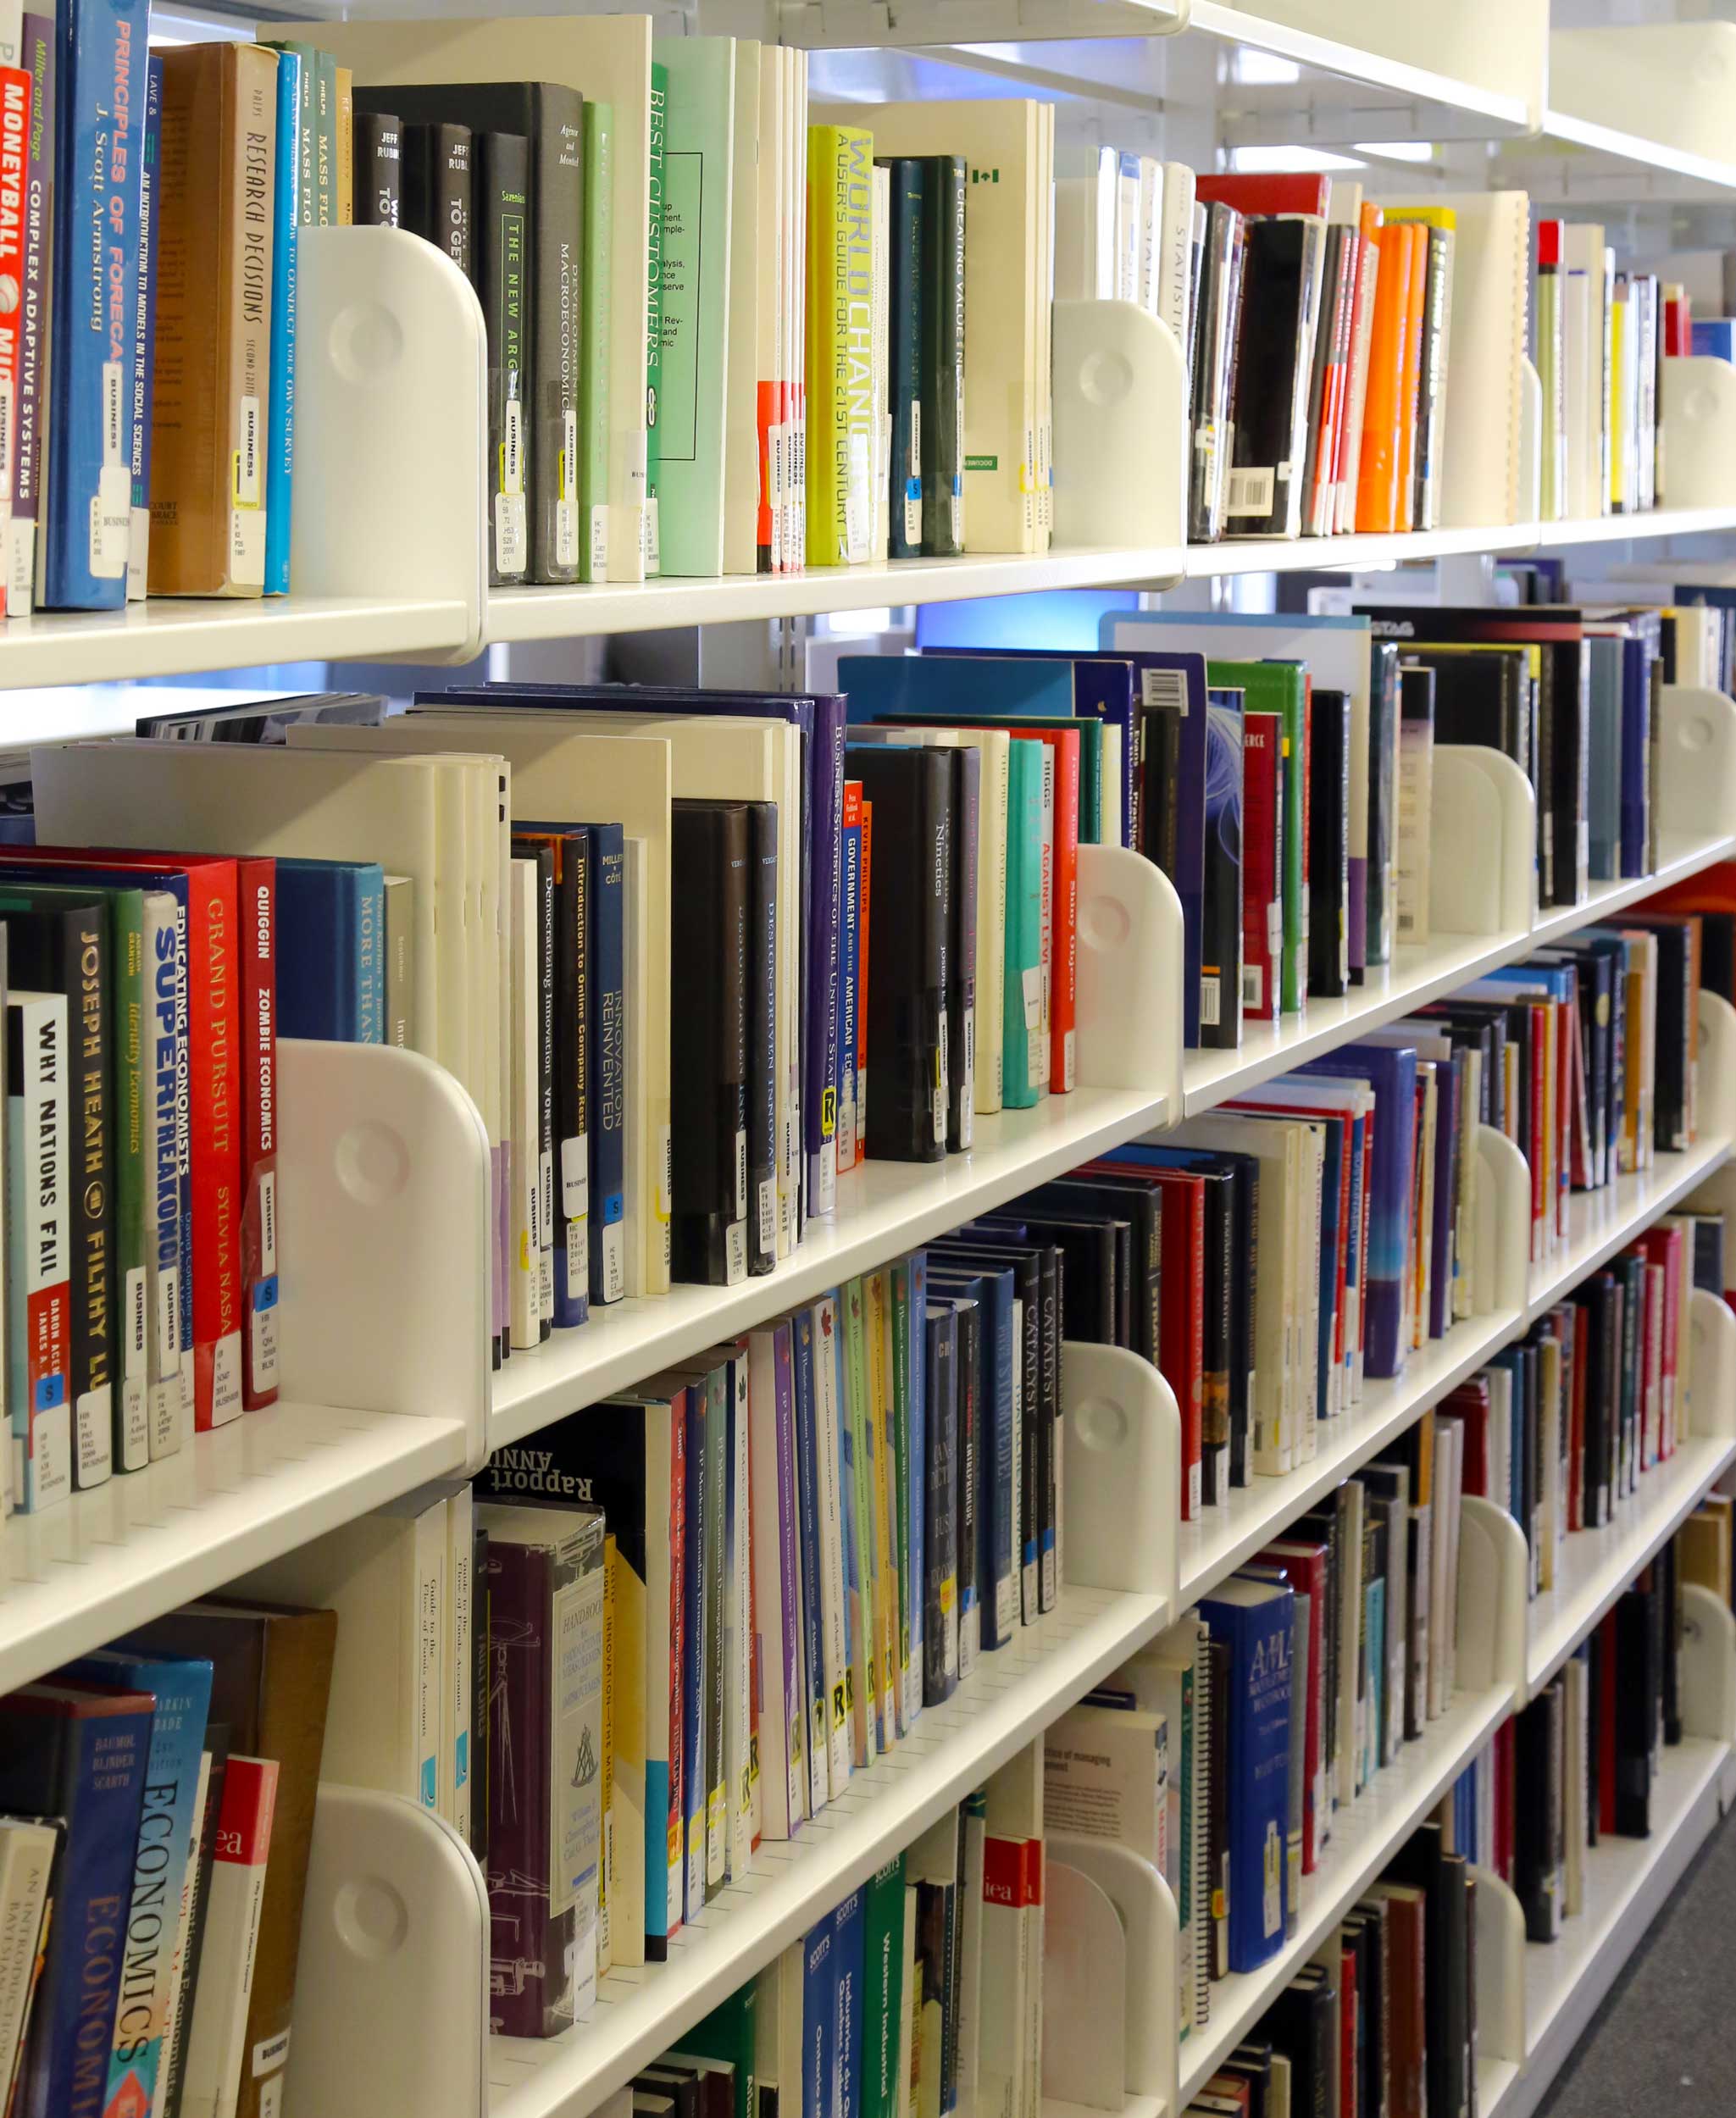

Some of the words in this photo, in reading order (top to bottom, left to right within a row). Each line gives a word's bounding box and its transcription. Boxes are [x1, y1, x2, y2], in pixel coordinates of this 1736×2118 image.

[33, 39, 47, 83] Miller
[149, 74, 158, 103] LAVE
[33, 86, 46, 119] and
[95, 103, 108, 122] J.
[109, 20, 130, 184] PRINCIPLES
[148, 106, 157, 116] &
[649, 88, 666, 169] BEST
[31, 121, 43, 162] Page
[92, 130, 108, 192] Scott
[302, 127, 311, 180] MASS
[318, 135, 328, 186] MASS
[381, 131, 398, 144] JEFF
[565, 141, 575, 151] and
[837, 133, 847, 147] A
[0, 82, 25, 257] MONEYBALL
[245, 132, 267, 223] RESEARCH
[501, 190, 526, 204] Saxenian
[835, 153, 848, 224] USER'S
[27, 179, 42, 282] COMPLEX
[109, 196, 125, 236] OF
[450, 198, 462, 225] TO
[507, 224, 519, 262] THE
[957, 189, 966, 277] CREATING
[89, 200, 107, 332] Armstrong
[137, 276, 147, 291] TO
[242, 231, 264, 324] DECISIONS
[646, 175, 662, 368] CUSTOMERS
[835, 230, 847, 290] GUIDE
[109, 247, 124, 365] FORECA
[135, 293, 147, 340] MODELS
[286, 268, 295, 336] CONDUCT
[507, 274, 519, 319] NEW
[835, 297, 847, 336] FOR
[956, 281, 965, 338] VALUE
[23, 288, 38, 396] ADAPTIVE
[134, 358, 144, 379] THE
[135, 342, 145, 355] IN
[246, 339, 256, 370] SECOND
[835, 344, 846, 380] THE
[132, 380, 144, 421] SOCIAL
[286, 379, 294, 415] OWN
[836, 385, 847, 434] 21ST
[19, 403, 33, 500] SYSTEMS
[131, 424, 142, 475] SCIENCES
[284, 417, 293, 475] SURVEY
[835, 440, 848, 525] CENTURY
[912, 483, 918, 495] S
[833, 725, 842, 807] BUSINESS
[1043, 761, 1051, 809] HIGGS
[831, 812, 840, 902] STATISTICS
[846, 838, 856, 930] GOVERNMENT
[935, 824, 945, 897] Nineties
[1042, 843, 1051, 918] AGAINST
[257, 886, 269, 959] QUIGGIN
[360, 896, 373, 968] MORE
[542, 876, 553, 989] Democratizing
[830, 908, 838, 928] OF
[1068, 880, 1077, 928] Shiny
[176, 906, 186, 1028] EDUCATING
[208, 898, 225, 1009] GRAND
[576, 952, 585, 969] to
[80, 931, 102, 1058] JOSEPH
[258, 988, 271, 1051] ZOMBIE
[360, 975, 374, 1044] THAN
[576, 974, 585, 1019] Online
[829, 972, 837, 1038] UNITED
[845, 976, 853, 1045] AMERICAN
[40, 1019, 56, 1083] WHY
[125, 1002, 141, 1065] Identity
[545, 994, 553, 1075] Innovation
[575, 1023, 585, 1090] Company
[602, 992, 613, 1131] REINVENTED
[614, 990, 623, 1128] INNOVATION
[129, 1069, 141, 1154] Economics
[177, 1035, 189, 1176] ECONOMISTS
[210, 1017, 229, 1152] PURSUIT
[259, 1056, 272, 1150] ECONOMICS
[823, 1091, 835, 1124] R
[40, 1099, 56, 1208] NATIONS
[83, 1072, 104, 1174] HEATH
[218, 1185, 233, 1267] SYLVIA
[613, 1201, 618, 1213] S
[40, 1220, 57, 1277] FAIL
[86, 1229, 108, 1339] FILTHY
[264, 1285, 272, 1302] S
[39, 1311, 47, 1347] JAMES
[51, 1299, 60, 1339] DARON
[1026, 1305, 1038, 1414] CATALYST
[45, 1383, 54, 1402] S
[491, 1469, 593, 1501] Rapport
[834, 1685, 845, 1719] R
[985, 1875, 1012, 1901] iea
[117, 1781, 178, 2064] ECONOMICS
[882, 1931, 890, 2008] Western
[70, 1894, 120, 2118] ECONOMI
[844, 1971, 852, 2062] Industries
[880, 2011, 890, 2098] Industrial
